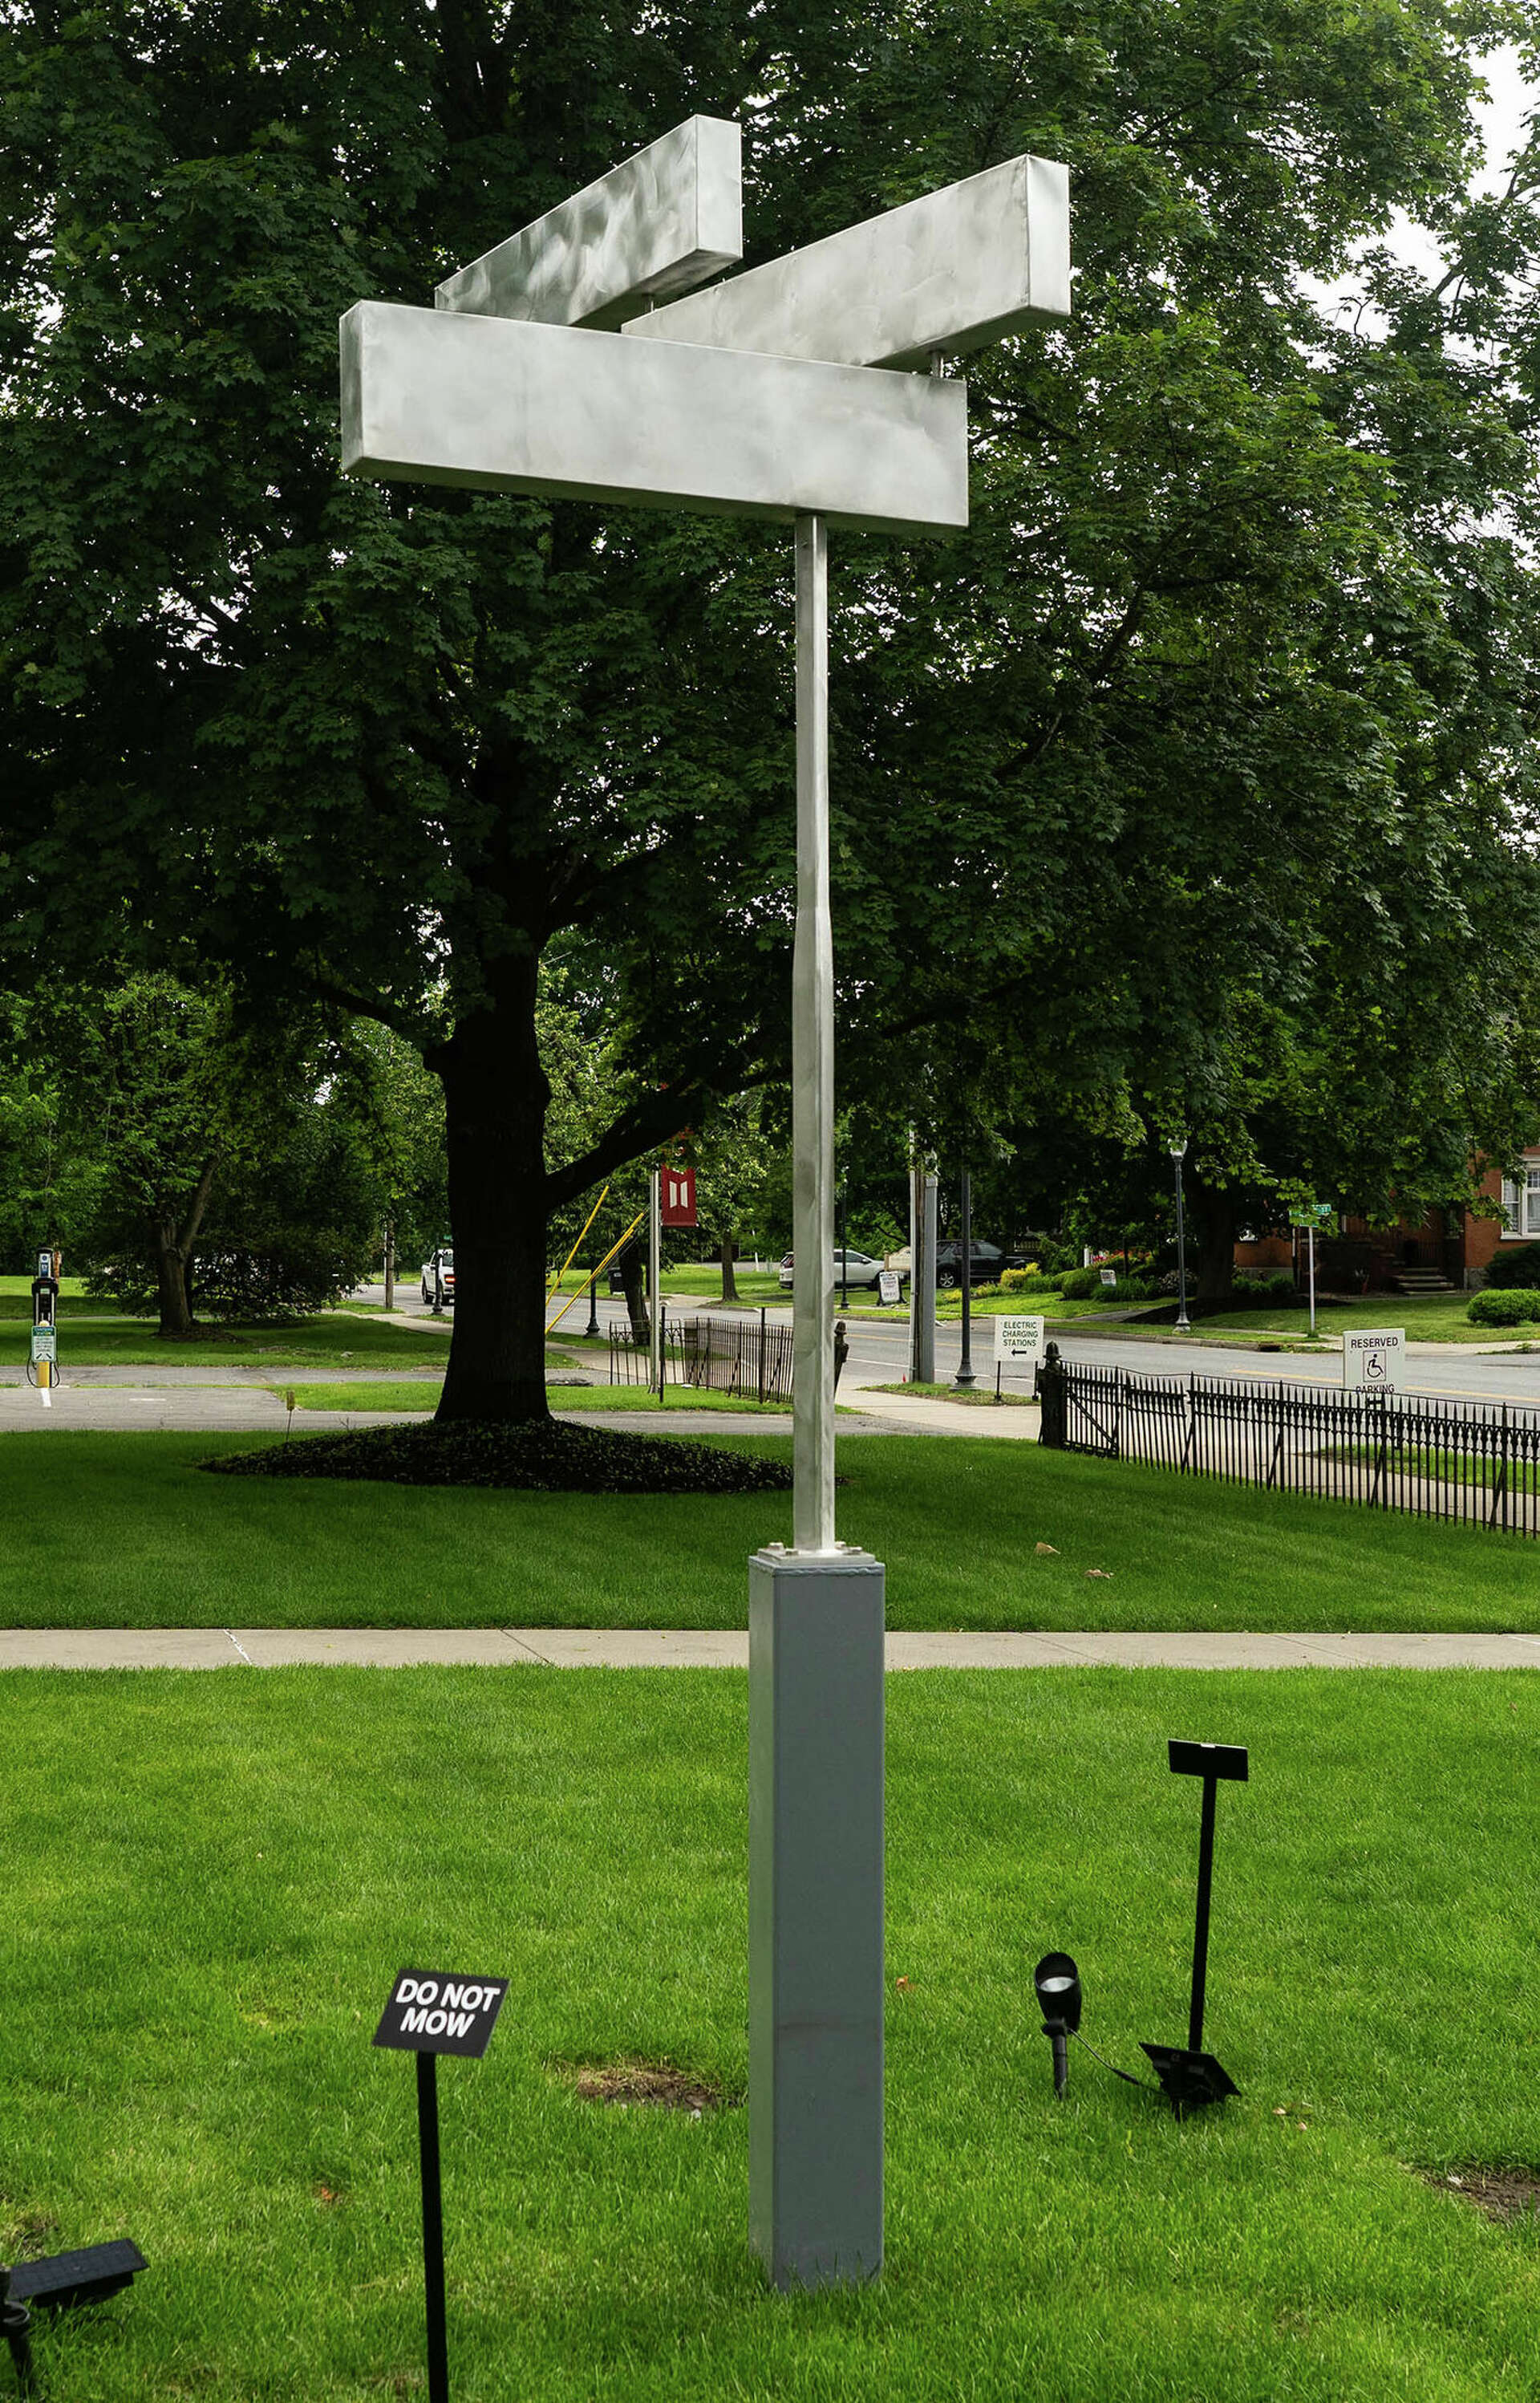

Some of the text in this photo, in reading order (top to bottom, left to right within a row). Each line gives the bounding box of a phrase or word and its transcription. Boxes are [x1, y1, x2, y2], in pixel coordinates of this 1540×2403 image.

[1003, 1330, 1039, 1338] CHARGING
[1351, 1337, 1398, 1349] RESERVED
[1356, 1383, 1395, 1394] PARKING
[395, 1979, 500, 2011] DO NOT
[399, 2007, 476, 2037] MOW
